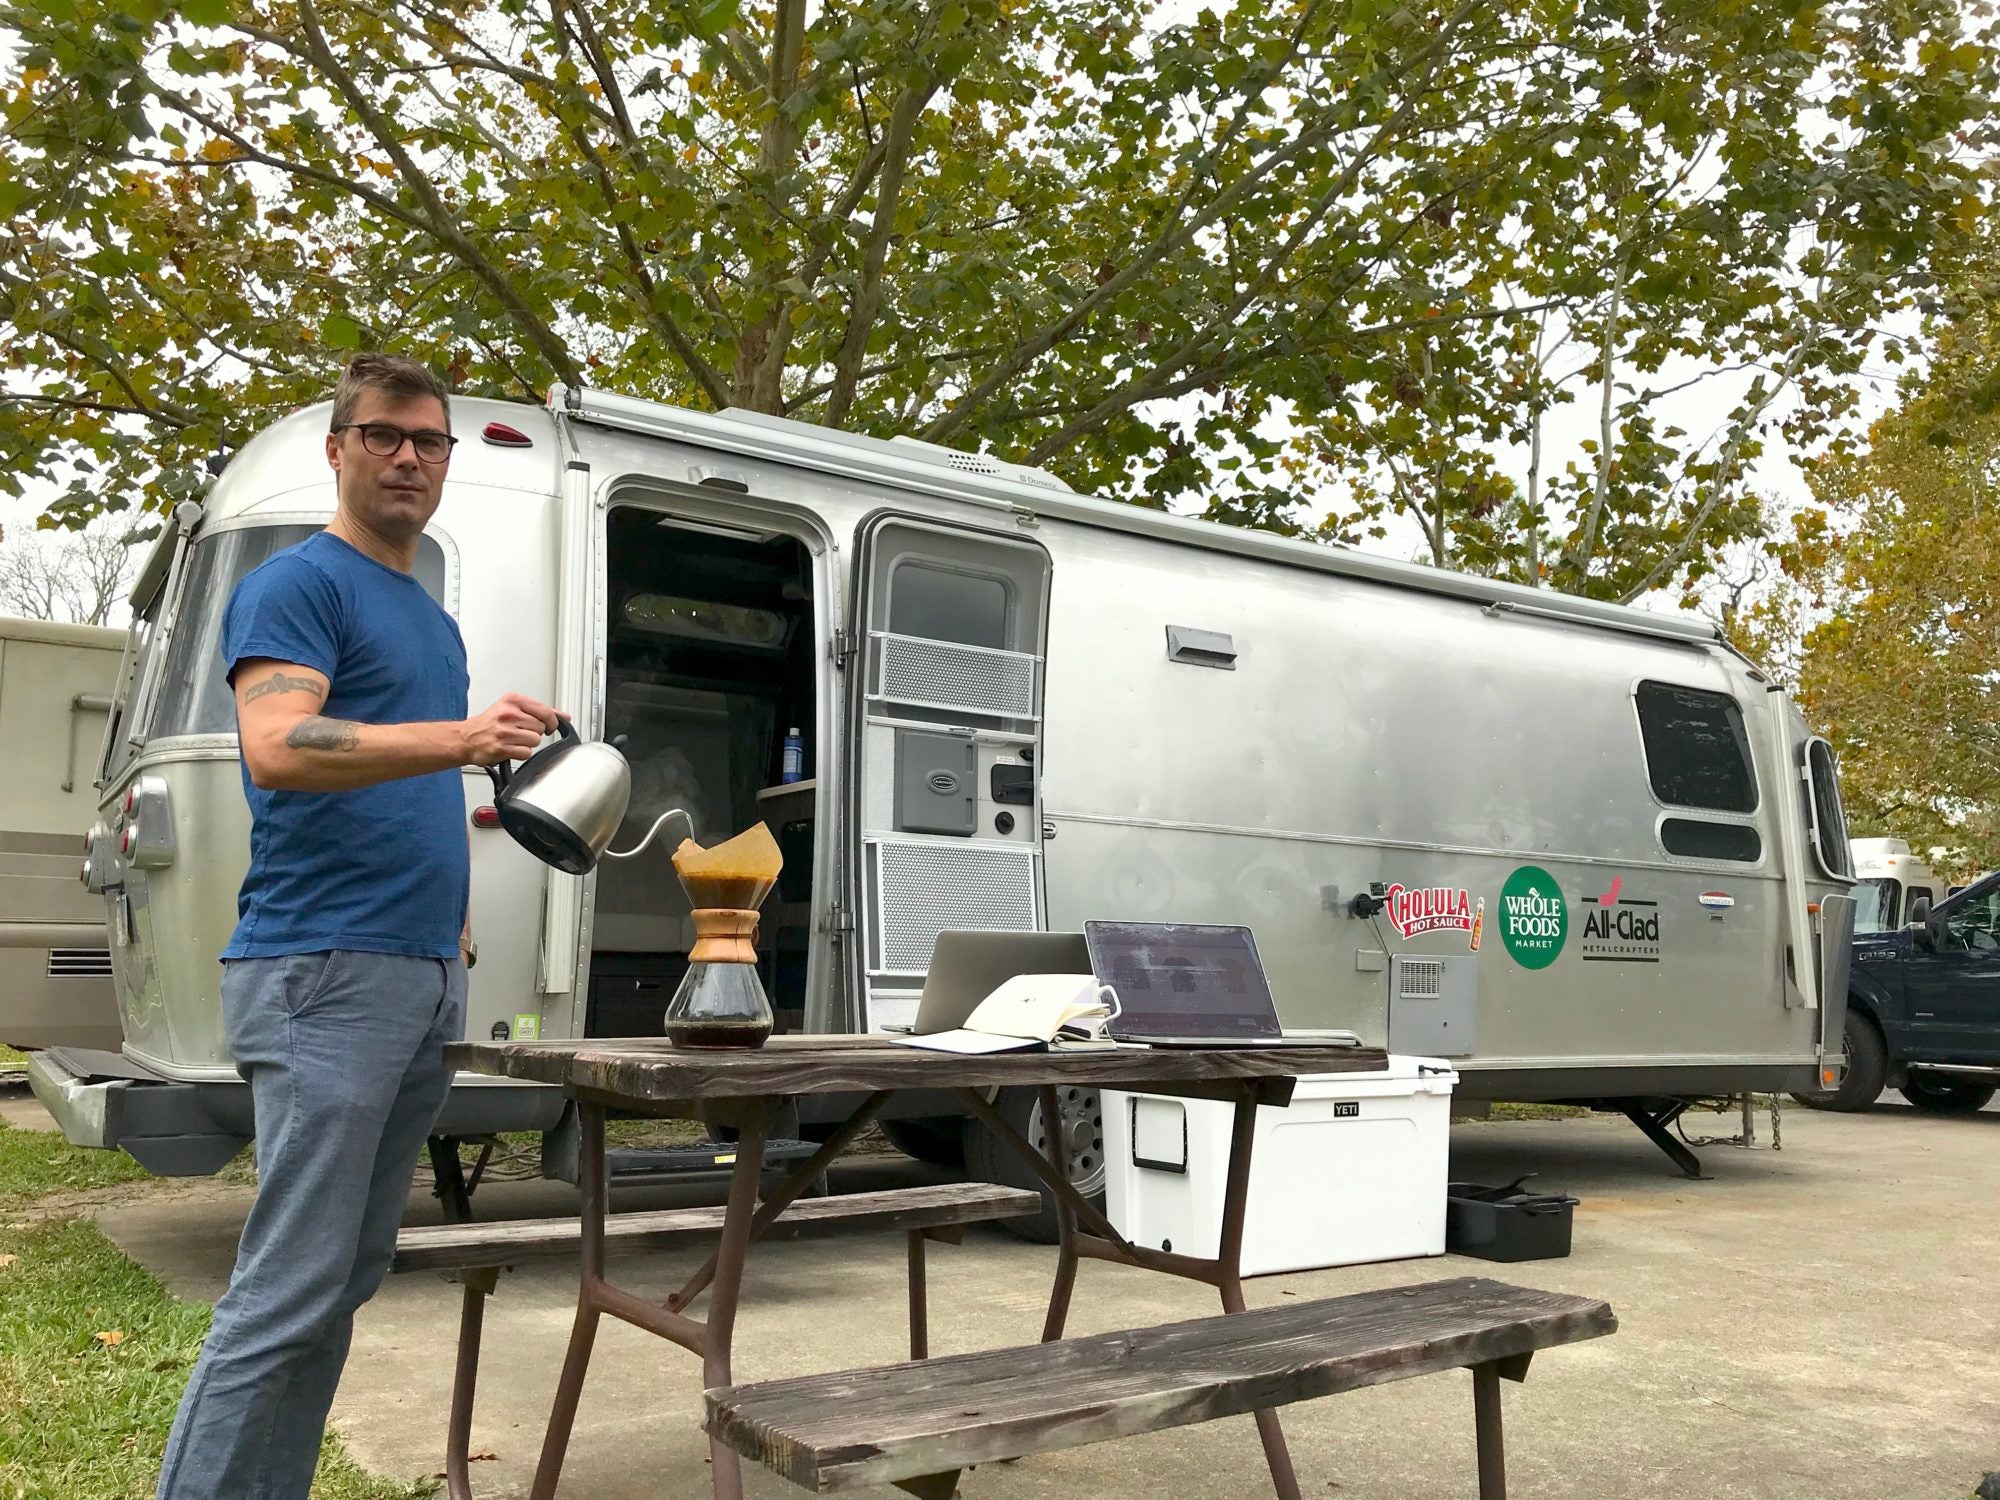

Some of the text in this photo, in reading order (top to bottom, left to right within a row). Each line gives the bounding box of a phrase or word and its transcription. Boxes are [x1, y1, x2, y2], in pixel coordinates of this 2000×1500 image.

[1387, 884, 1471, 933] CHOLULA
[1505, 895, 1561, 917] WHOLE
[1410, 917, 1465, 934] HOT SAUCE
[1509, 916, 1561, 937] FOODS
[1582, 909, 1659, 942] All-Clad
[1515, 939, 1553, 948] MARKET
[1582, 945, 1660, 954] METALCRAFTERS
[1335, 1104, 1358, 1115] YETI
